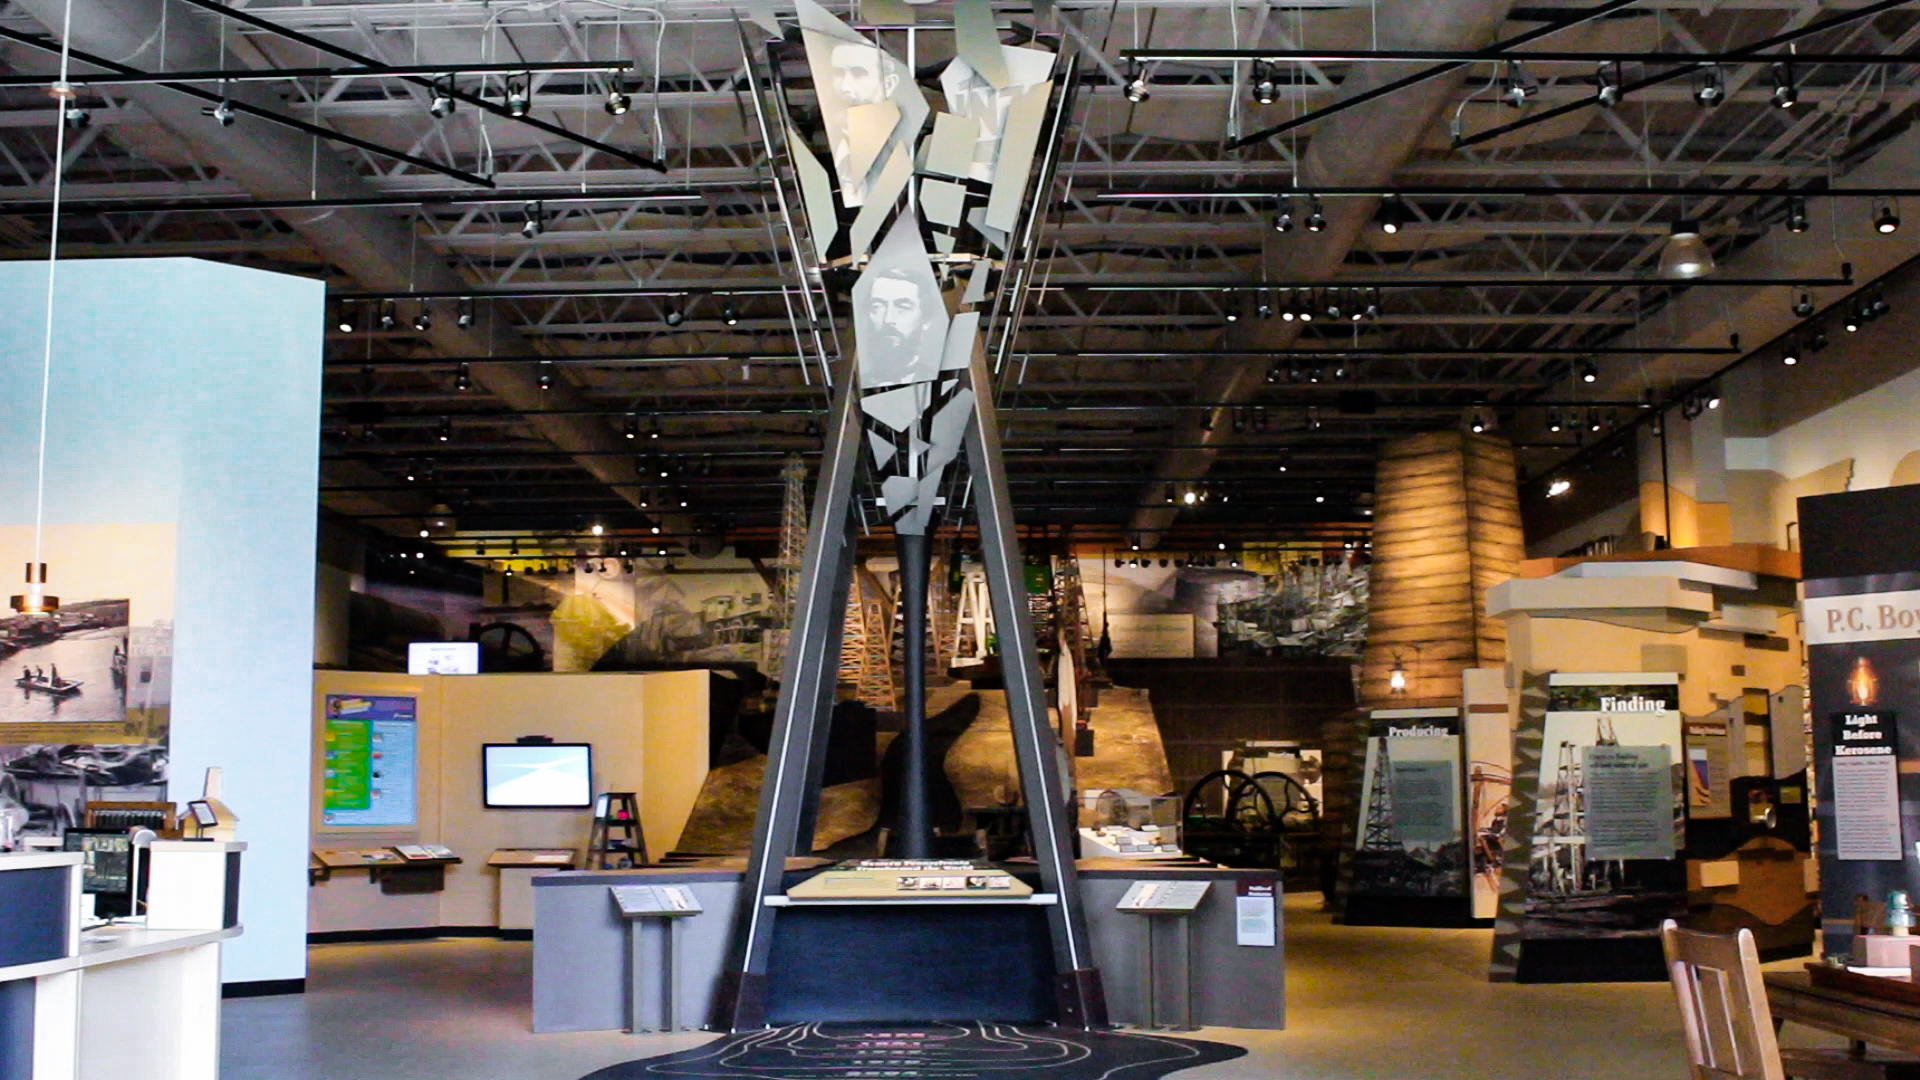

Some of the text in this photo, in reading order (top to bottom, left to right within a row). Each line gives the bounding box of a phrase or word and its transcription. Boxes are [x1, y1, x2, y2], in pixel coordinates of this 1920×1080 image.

[1827, 607, 1872, 633] P.C.
[1600, 695, 1667, 717] Finding
[1845, 714, 1878, 727] Light
[1389, 725, 1449, 741] Producing
[1842, 729, 1883, 740] Before
[1834, 745, 1892, 756] Kerosene
